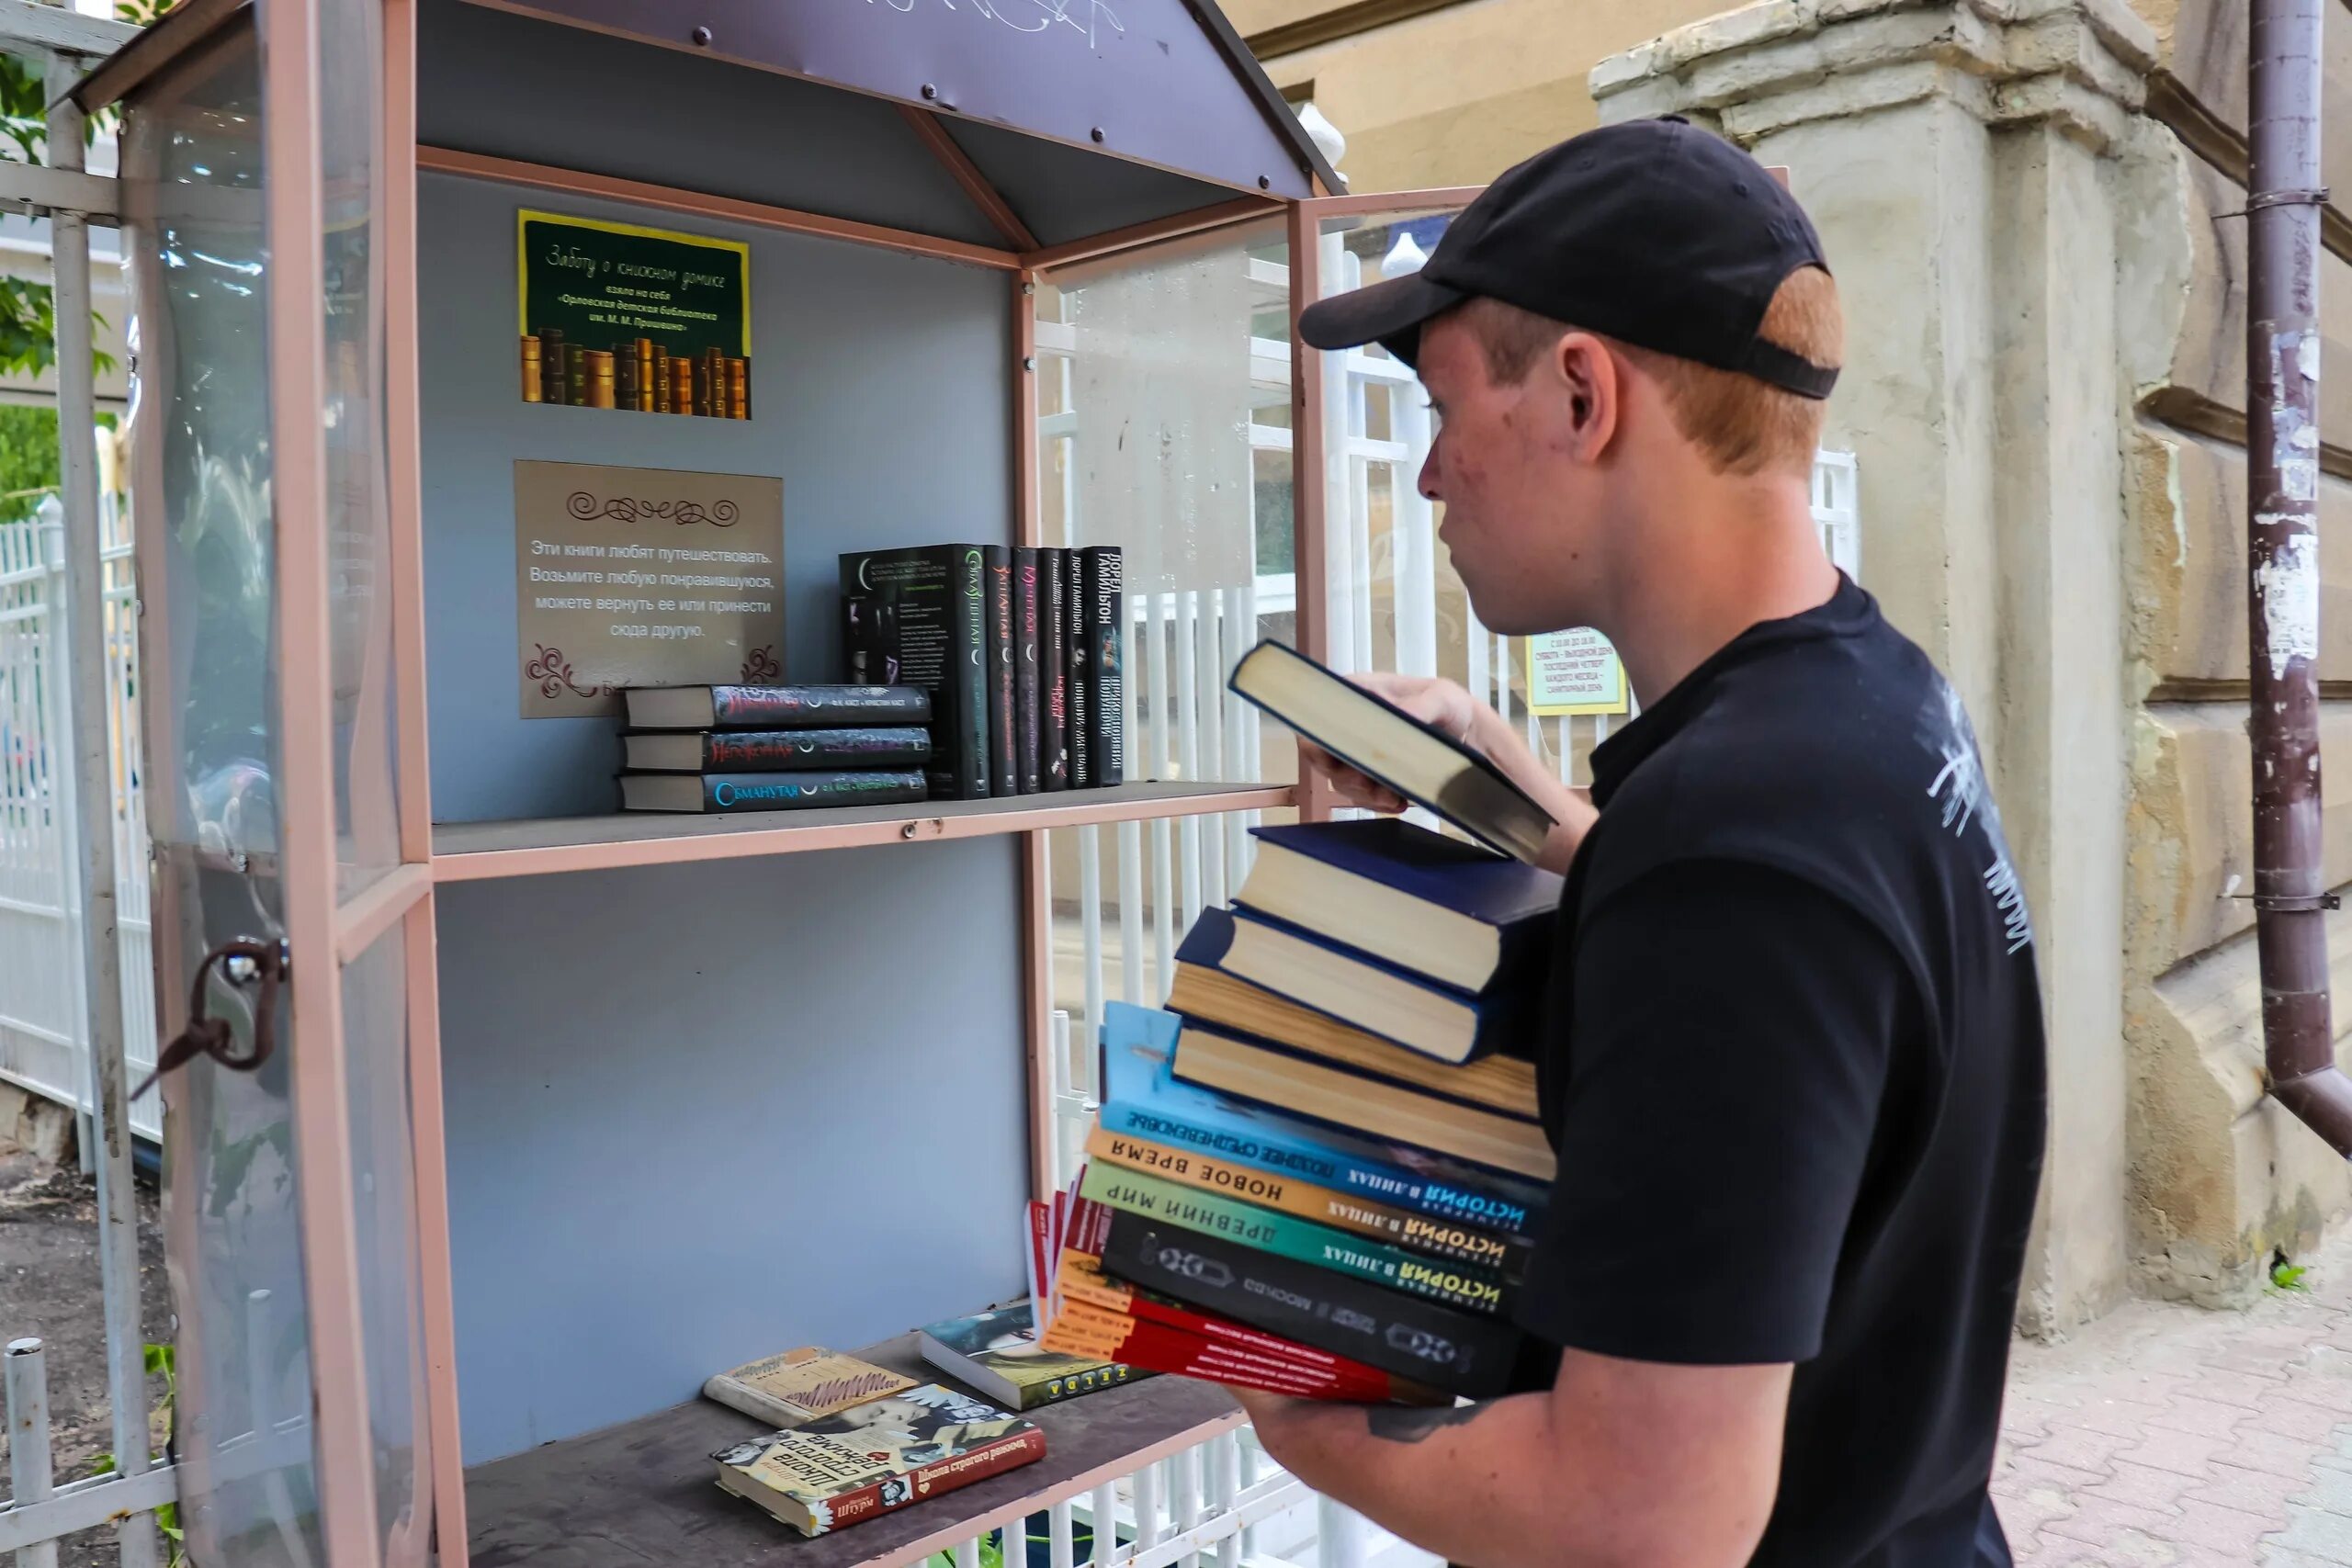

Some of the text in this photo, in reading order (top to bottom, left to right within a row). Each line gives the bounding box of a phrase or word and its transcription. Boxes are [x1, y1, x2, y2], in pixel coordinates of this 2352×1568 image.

[546, 244, 596, 278] Заботу
[603, 261, 610, 272] о
[681, 272, 725, 290] домике
[617, 299, 659, 314] детская
[660, 306, 718, 321] библиотека
[649, 290, 671, 300] себя
[531, 540, 773, 565] Эти книги любят путешествовать.
[530, 567, 775, 591] Возьмите любую понравившуюся,
[1098, 553, 1111, 624] ГАМИЛЬТОН
[1111, 553, 1121, 592] ЛОРЕЛ
[536, 596, 772, 615] можете вернуть ее или принести
[1072, 556, 1082, 635] ЛОРЕЛ ГАМИЛЬТОН
[610, 624, 707, 639] сюда другую.
[1127, 1111, 1335, 1179] ПОЗДНЕЕ СРЕДНЕВЕКОВЬЕ
[1112, 1140, 1283, 1201] НОВОЕ ВРЕМЯ
[1107, 1186, 1278, 1243] ДРЕВНИЙ МИР
[1348, 1169, 1525, 1223] ИСТОРИЯ В ЛИЦАХ
[1328, 1201, 1506, 1258] ИСТОРИЯ В ЛИЦАХ
[1323, 1245, 1501, 1303] ИСТОРИЯ В ЛИЦАХ
[773, 1453, 840, 1486] Школа
[779, 1439, 860, 1477] строгого
[806, 1435, 889, 1469] режима
[918, 1438, 1027, 1483] Школа строгого режима,
[837, 1498, 874, 1517] Штурм
